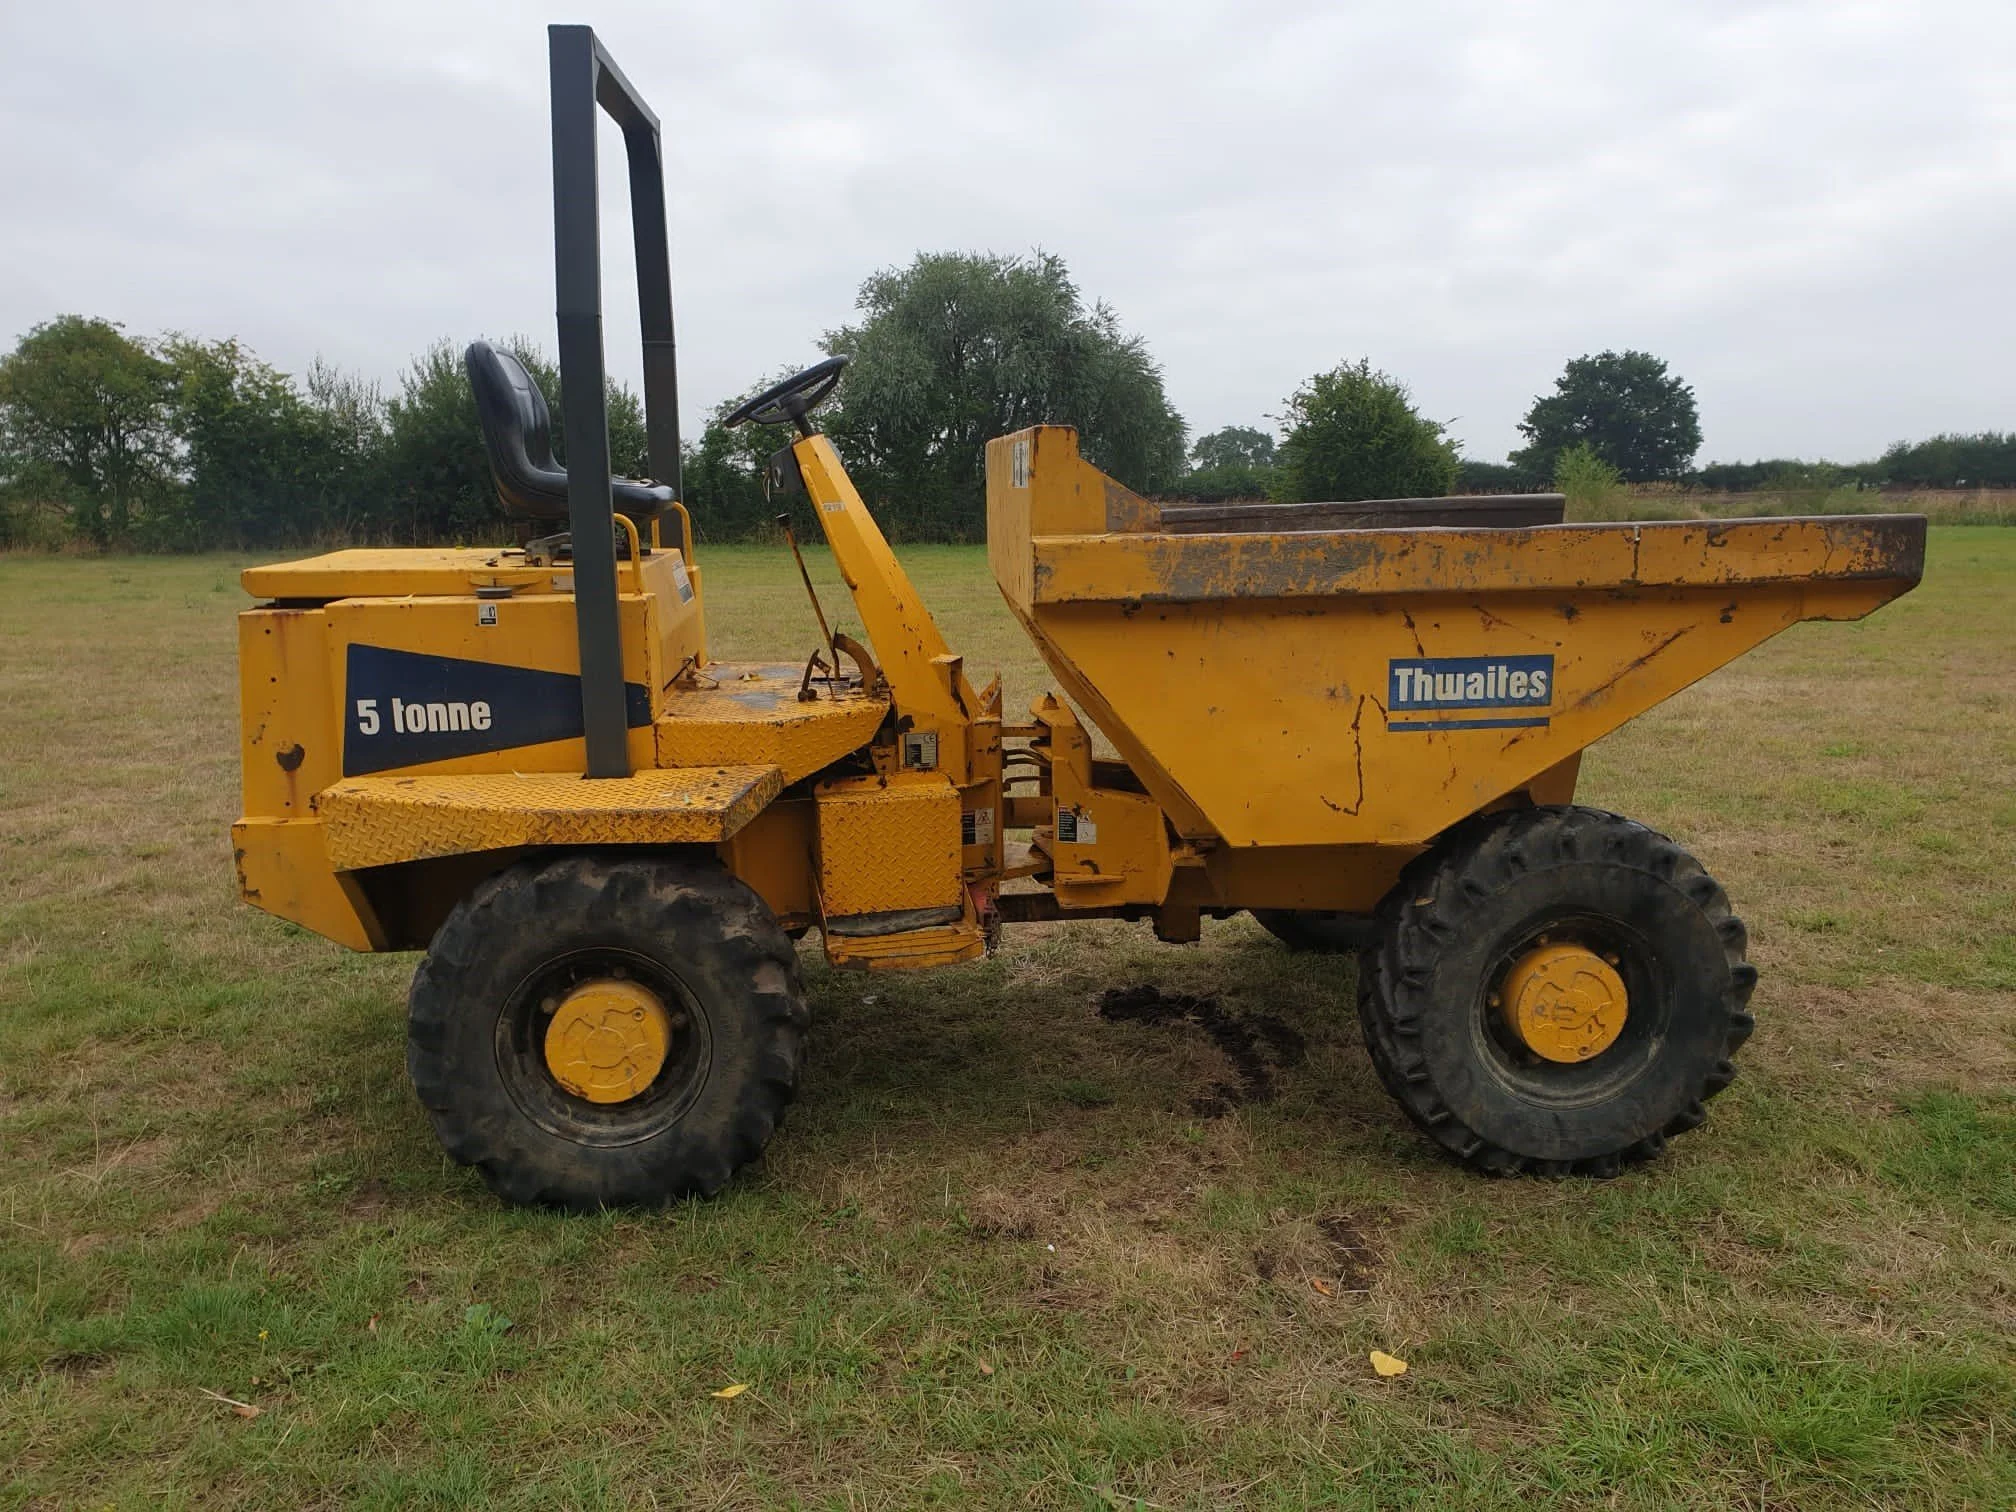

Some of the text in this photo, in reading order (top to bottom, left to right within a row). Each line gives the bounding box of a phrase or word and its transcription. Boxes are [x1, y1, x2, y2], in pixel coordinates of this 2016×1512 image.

[1394, 664, 1547, 702] Thwaites
[356, 697, 492, 735] 5 tonne
